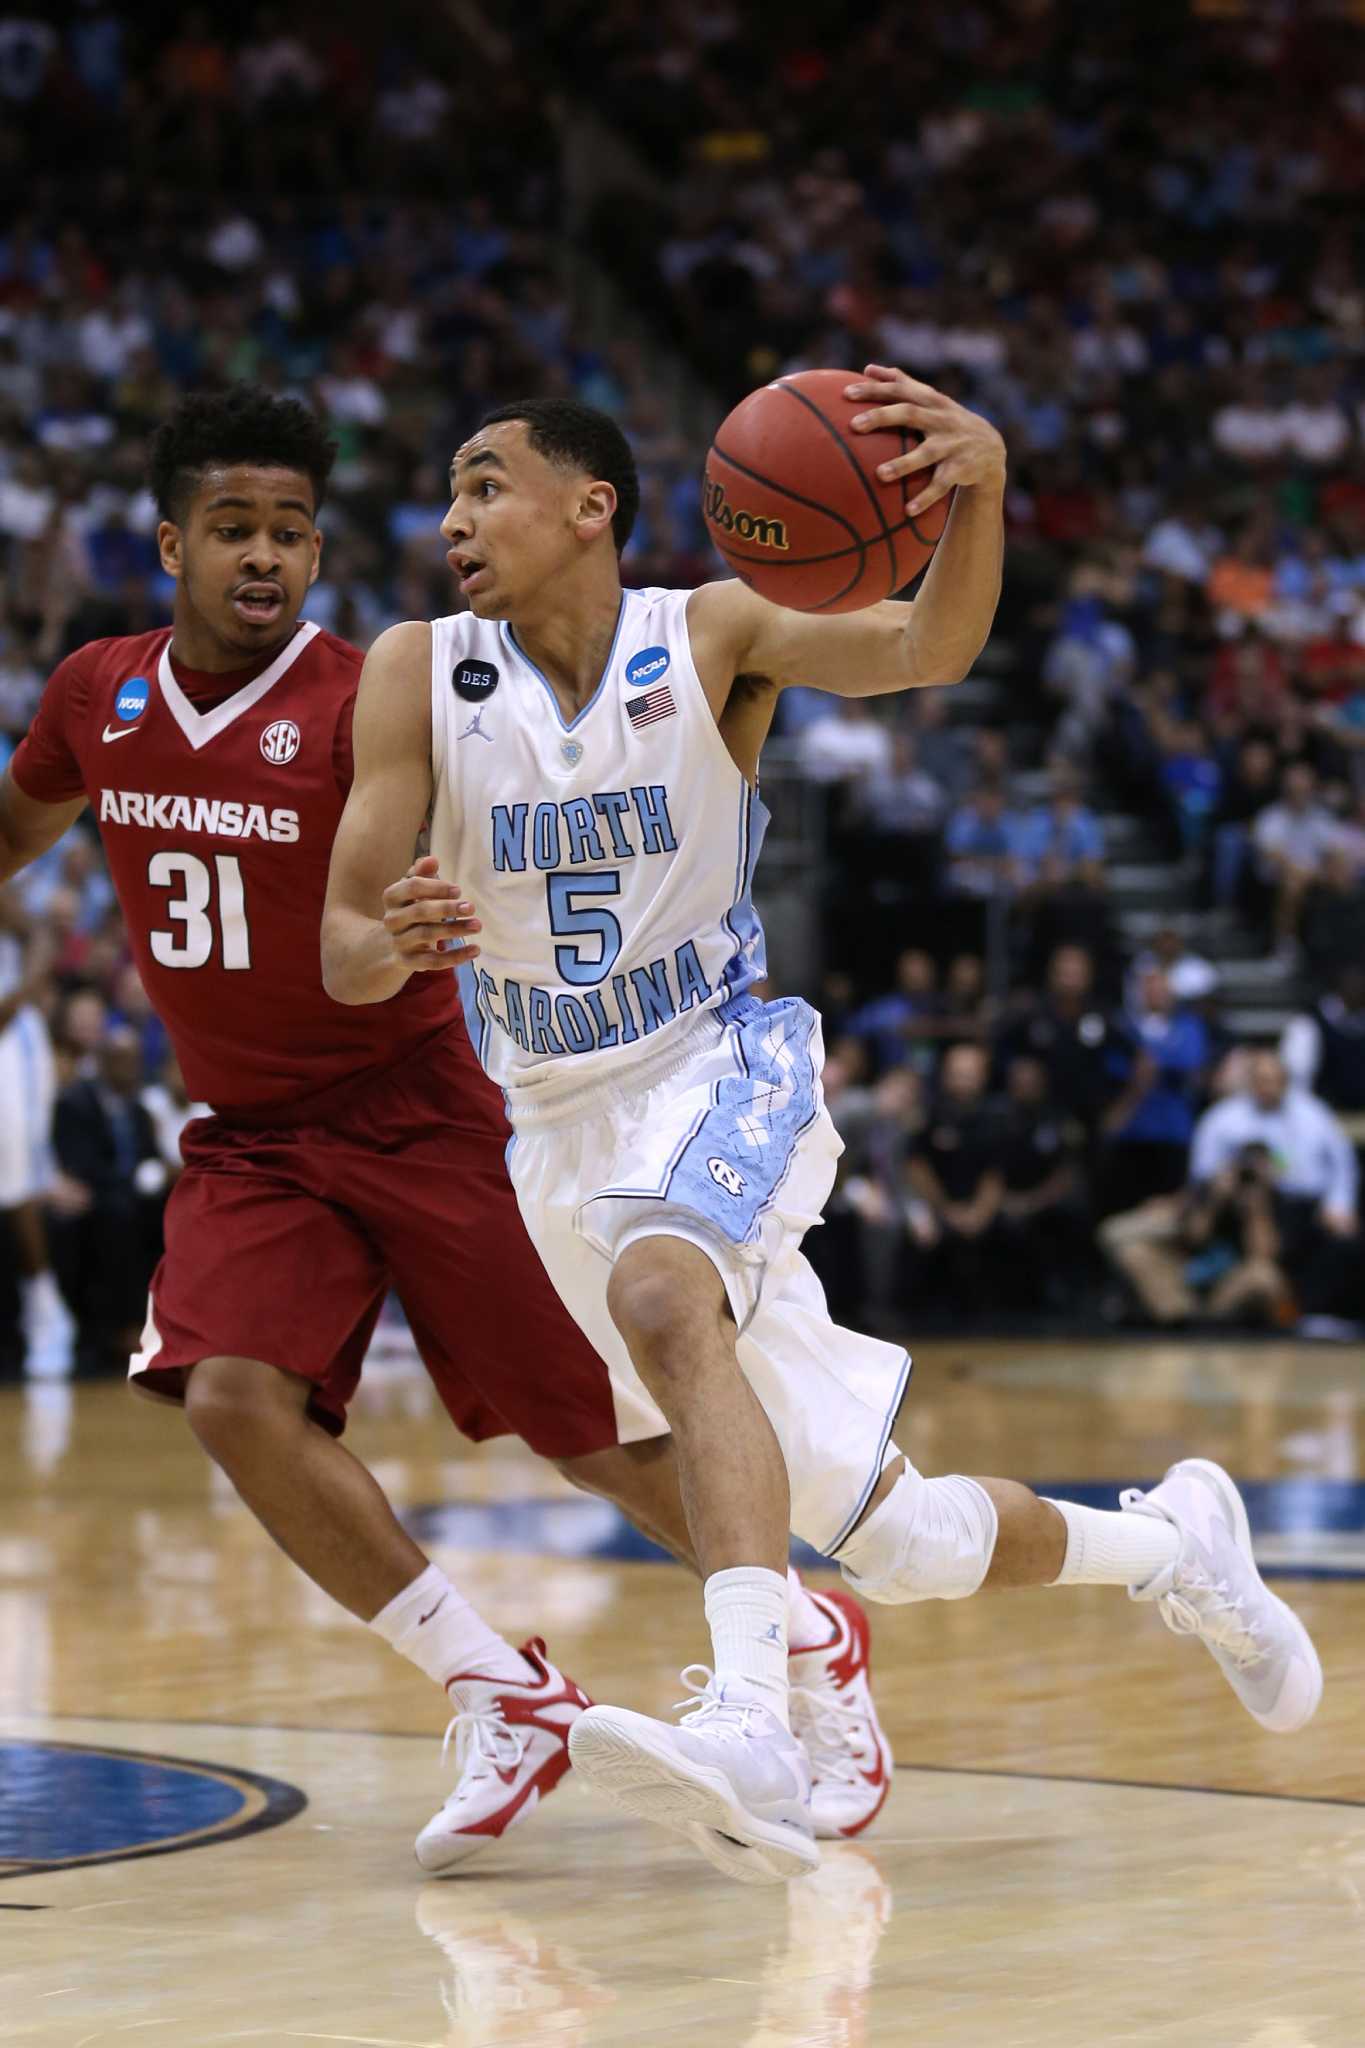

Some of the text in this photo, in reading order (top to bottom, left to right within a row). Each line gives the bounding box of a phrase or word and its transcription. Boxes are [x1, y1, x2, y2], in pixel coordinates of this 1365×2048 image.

[704, 483, 790, 550] ilson
[264, 723, 298, 761] SEC
[100, 788, 300, 843] ARKANSAS
[491, 785, 678, 872] NORTH
[147, 851, 252, 970] 31
[545, 870, 623, 987] 5
[479, 939, 713, 1054] CAROLINA
